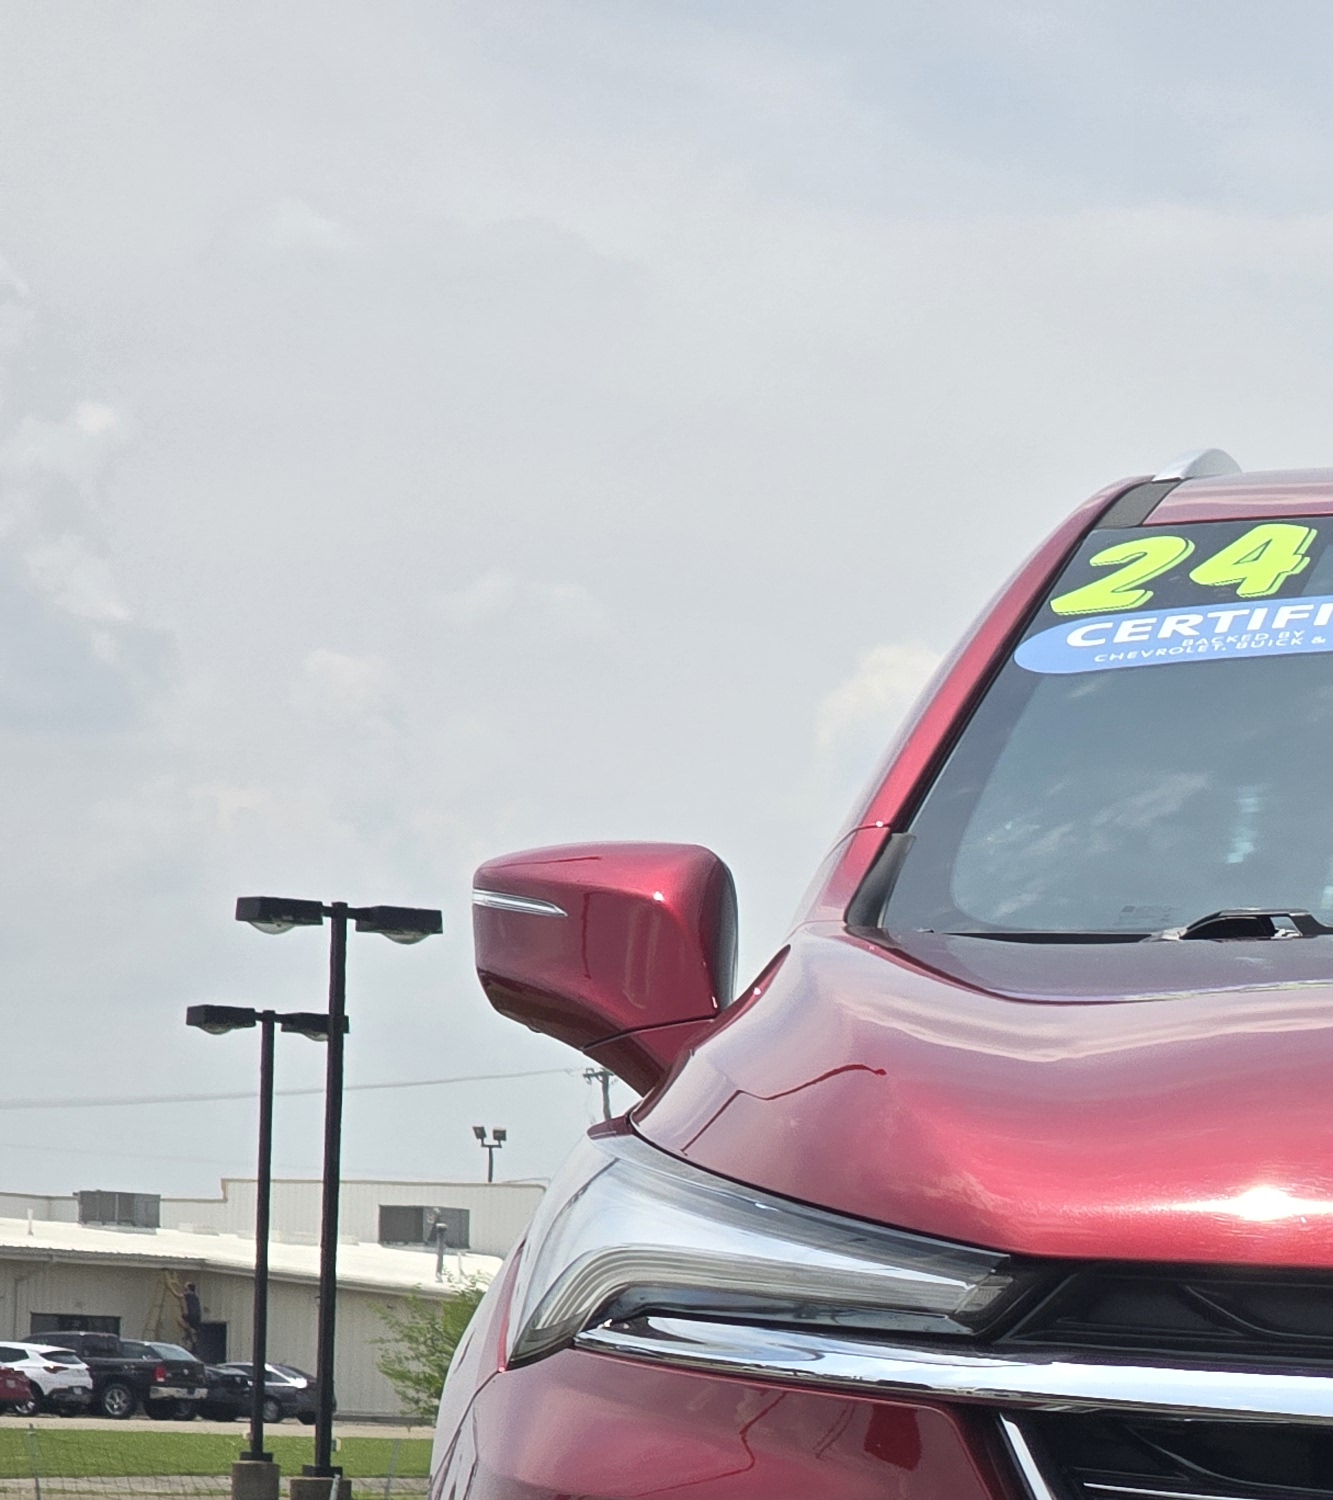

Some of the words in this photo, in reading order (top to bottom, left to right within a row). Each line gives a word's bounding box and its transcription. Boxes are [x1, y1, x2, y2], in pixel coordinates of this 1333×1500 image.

[1050, 523, 1317, 615] 24
[1182, 632, 1270, 648] BACKED
[1279, 629, 1306, 640] BY
[1235, 636, 1304, 650] BUICK
[1311, 635, 1325, 645] &
